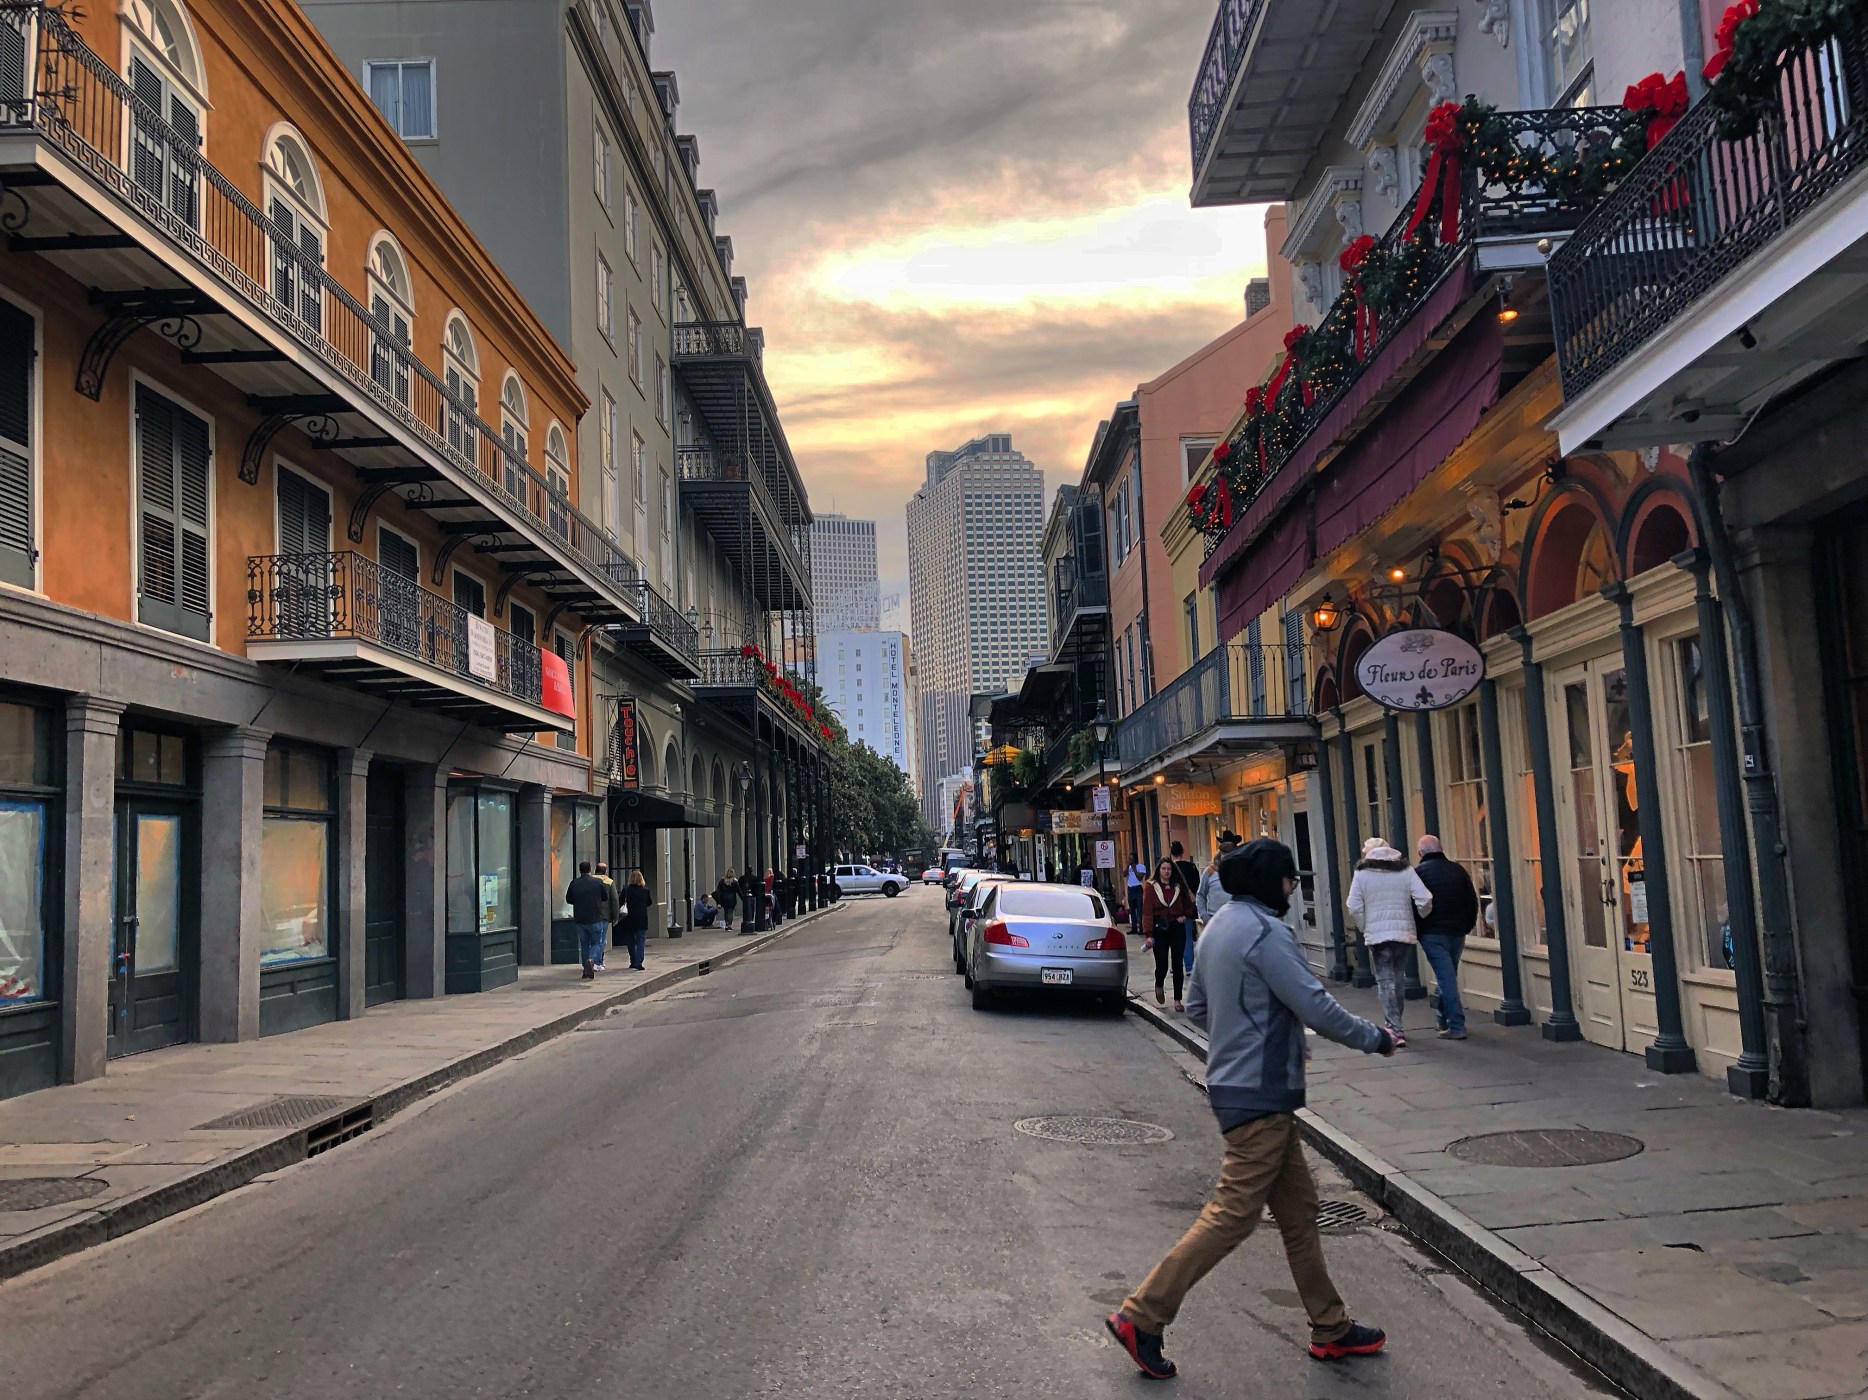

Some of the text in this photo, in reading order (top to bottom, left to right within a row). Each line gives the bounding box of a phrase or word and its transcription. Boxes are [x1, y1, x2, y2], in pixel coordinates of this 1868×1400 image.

[1366, 657, 1478, 686] Fleur de Paris
[891, 682, 901, 754] MONTELEONE
[1171, 788, 1210, 800] Sutton
[1165, 799, 1217, 811] Galleries
[1631, 969, 1649, 988] 523
